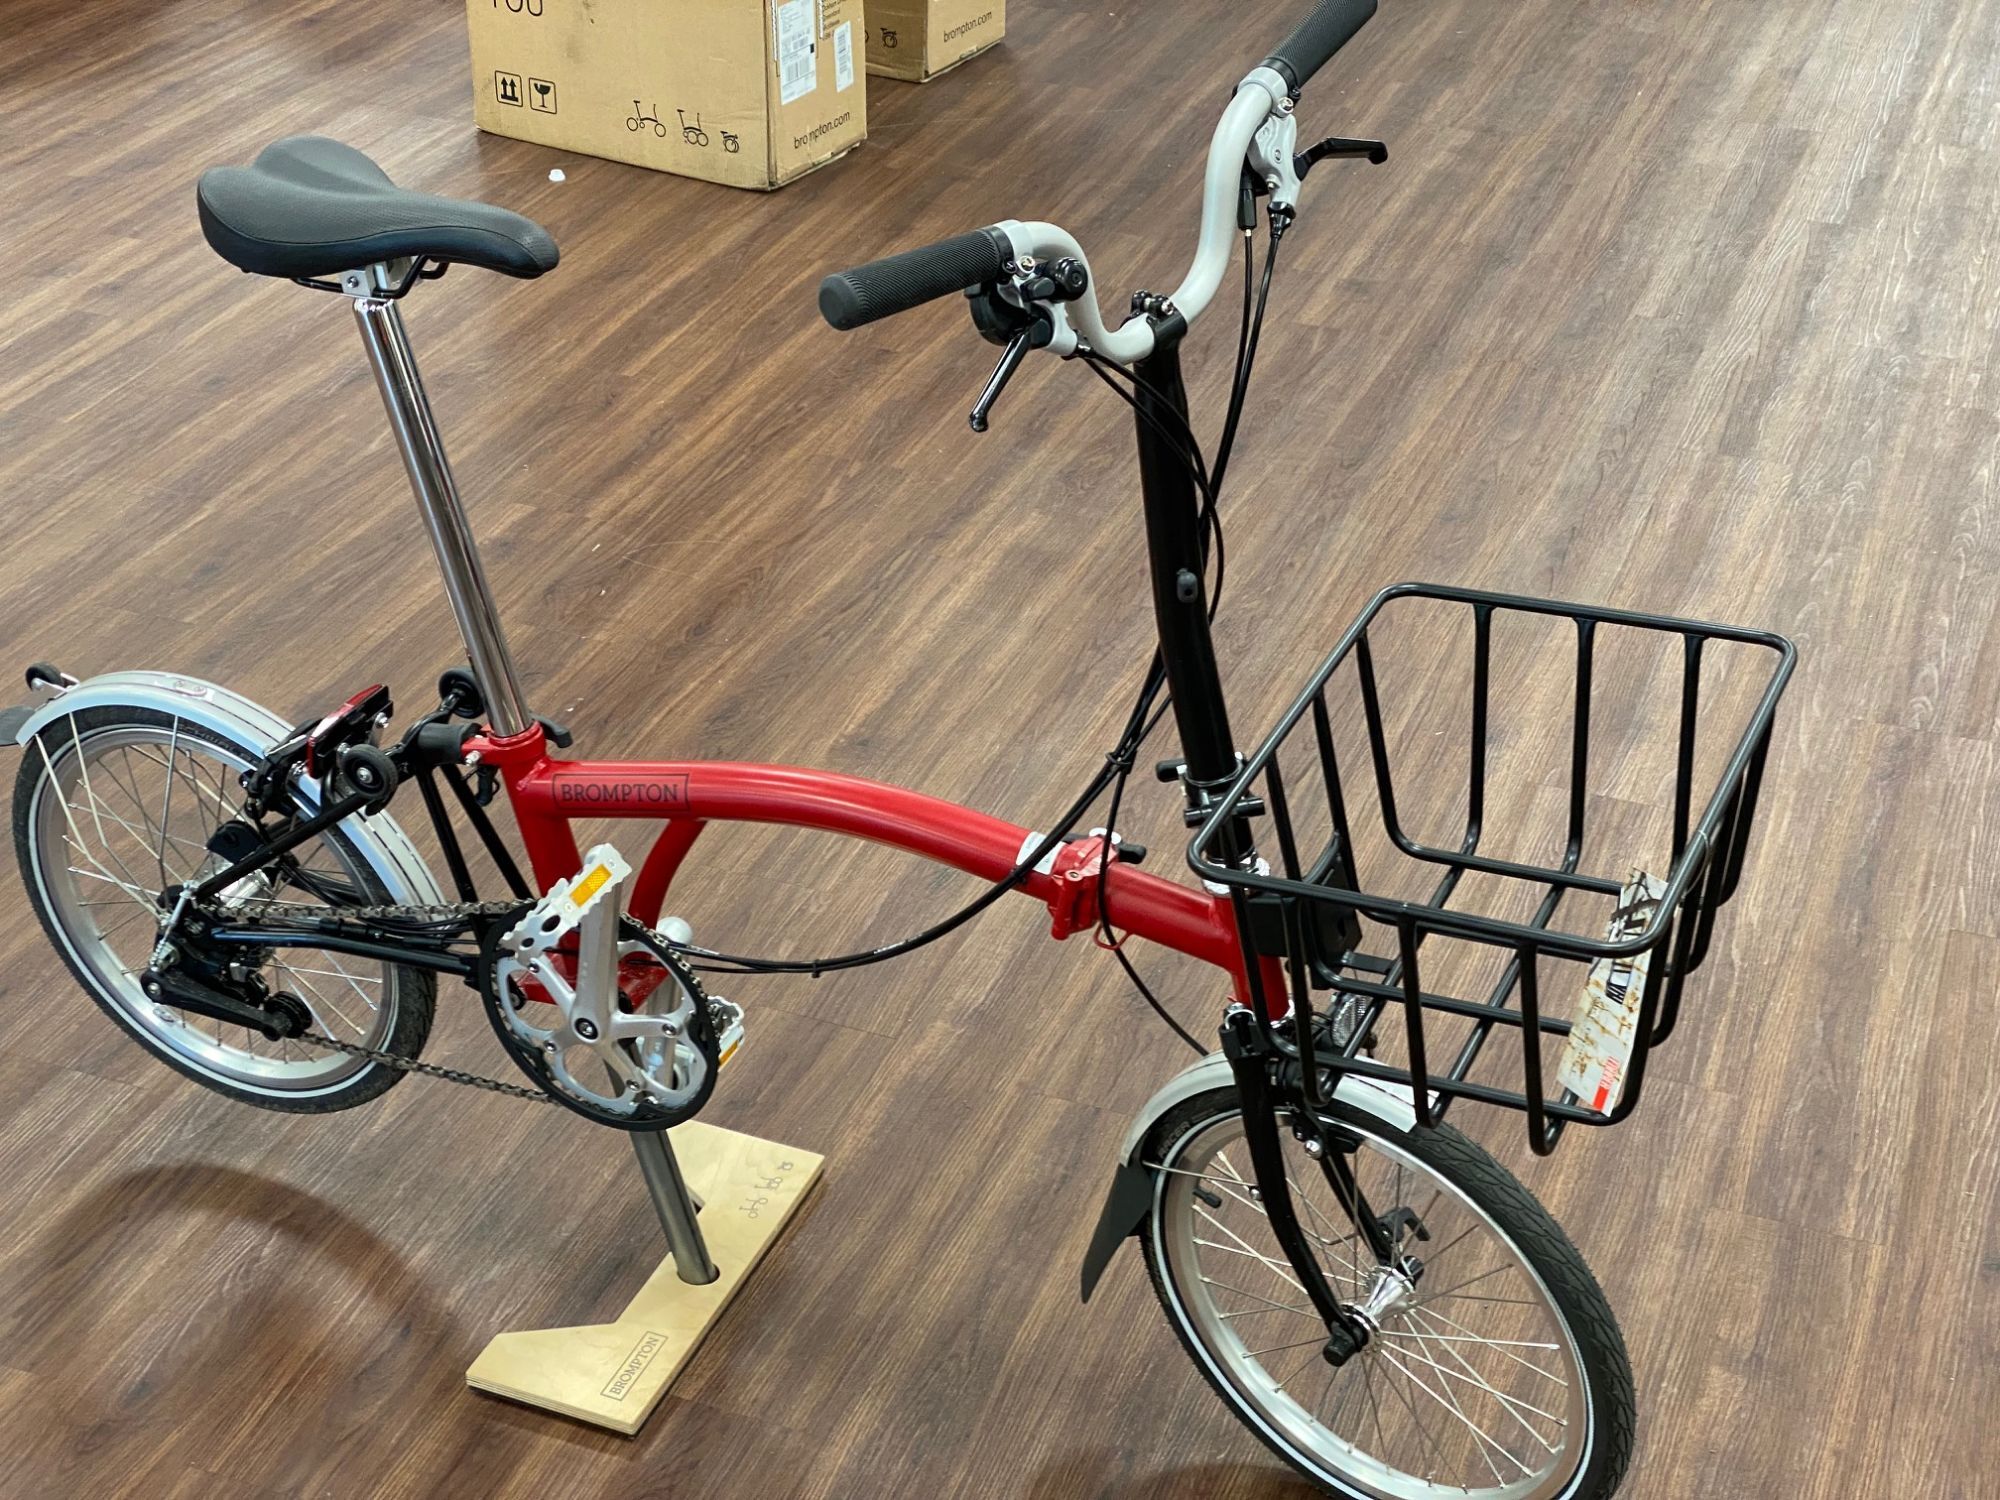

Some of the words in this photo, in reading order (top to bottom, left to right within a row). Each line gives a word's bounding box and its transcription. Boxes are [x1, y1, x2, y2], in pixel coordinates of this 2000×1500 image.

[943, 11, 993, 43] brompton.com
[794, 111, 851, 149] brompton.com
[560, 783, 678, 803] BROMPTON
[609, 1336, 660, 1396] BROMPTON
